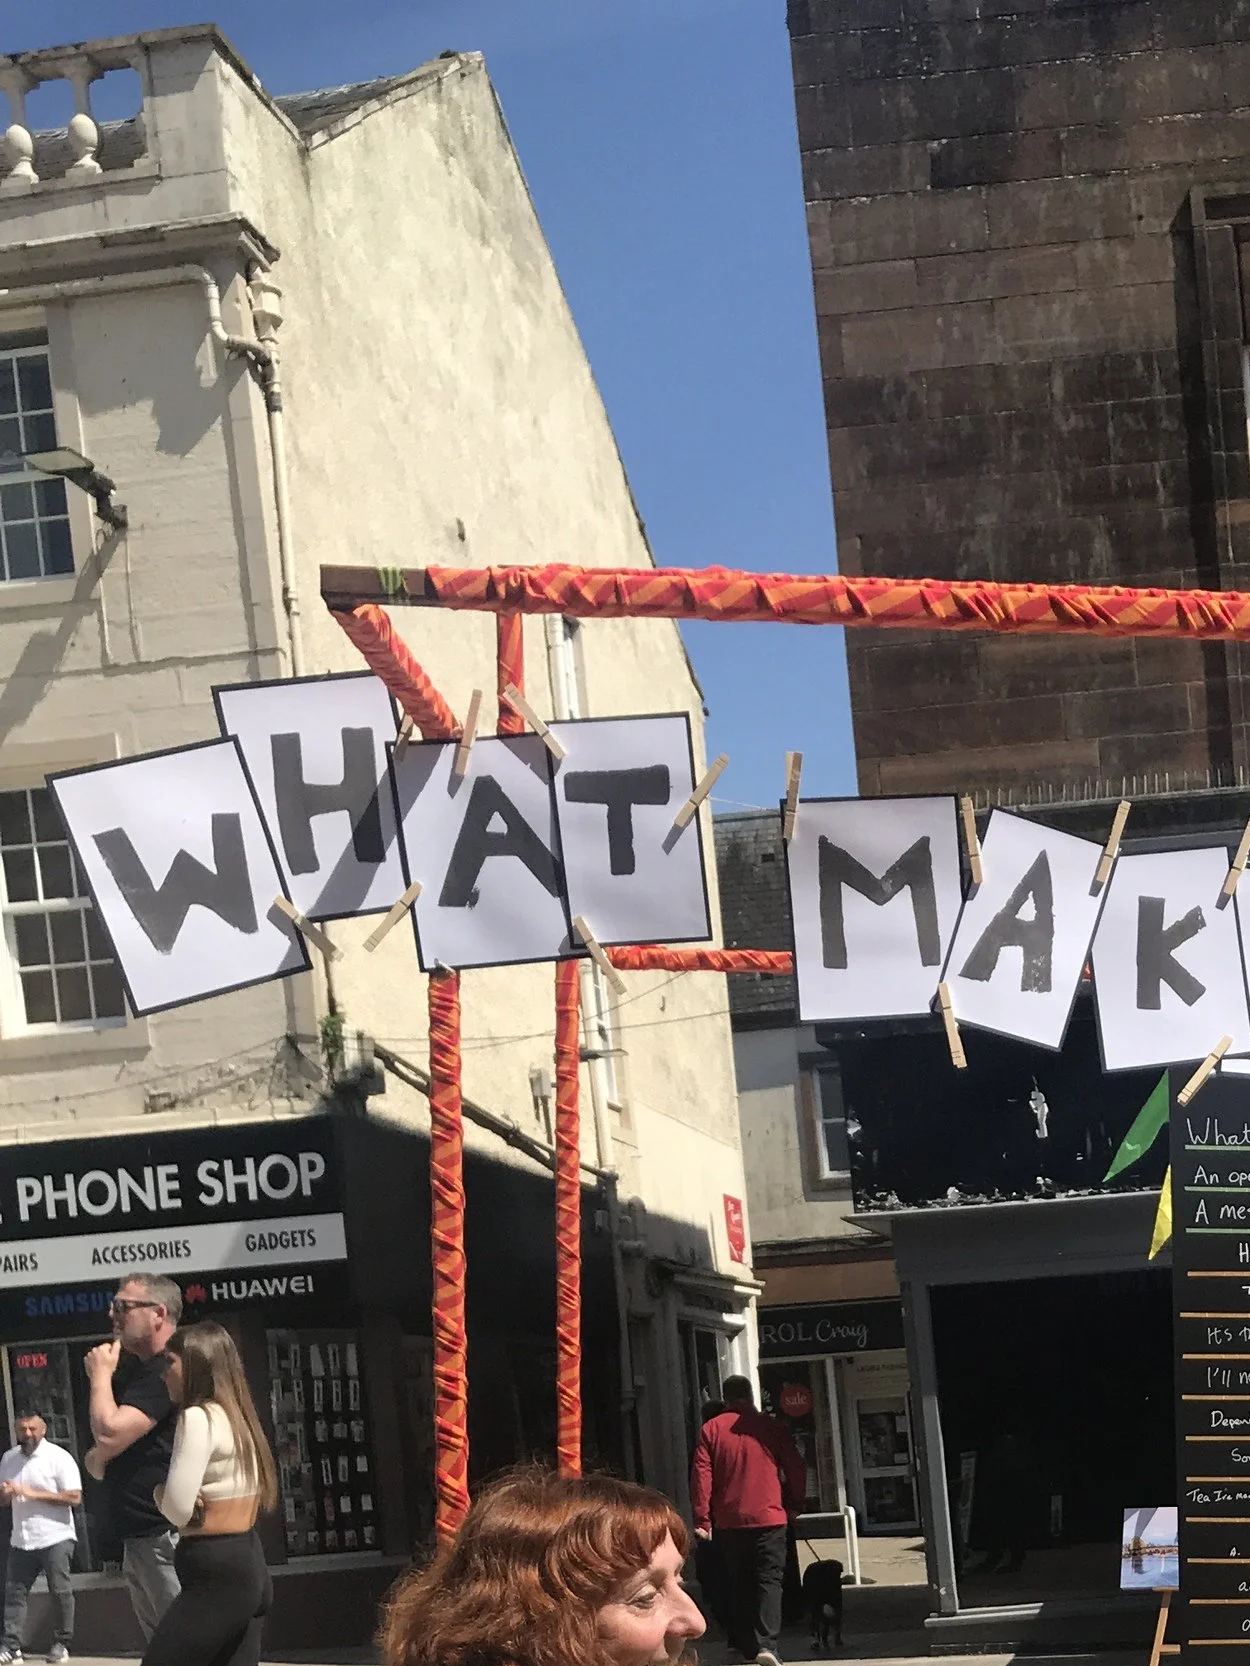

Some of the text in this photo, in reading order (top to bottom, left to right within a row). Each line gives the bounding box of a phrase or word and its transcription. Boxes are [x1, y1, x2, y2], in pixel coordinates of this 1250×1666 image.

[93, 727, 671, 955] WHAT
[1194, 1165, 1219, 1184] An
[17, 1152, 326, 1222] PHONE SHOP
[1195, 1199, 1210, 1225] A
[245, 1229, 317, 1252] GADGETS
[0, 1252, 39, 1274] AIRS
[91, 1239, 192, 1266] ACCESSORIES
[212, 1275, 314, 1301] HUAWEI
[25, 1292, 114, 1317] SAMSU
[761, 1318, 870, 1348] ROL Craig
[1207, 1325, 1233, 1345] It's
[16, 1352, 48, 1369] OPEN
[1207, 1366, 1232, 1388] I'll
[784, 1391, 808, 1406] sale
[1186, 1488, 1211, 1503] Tea
